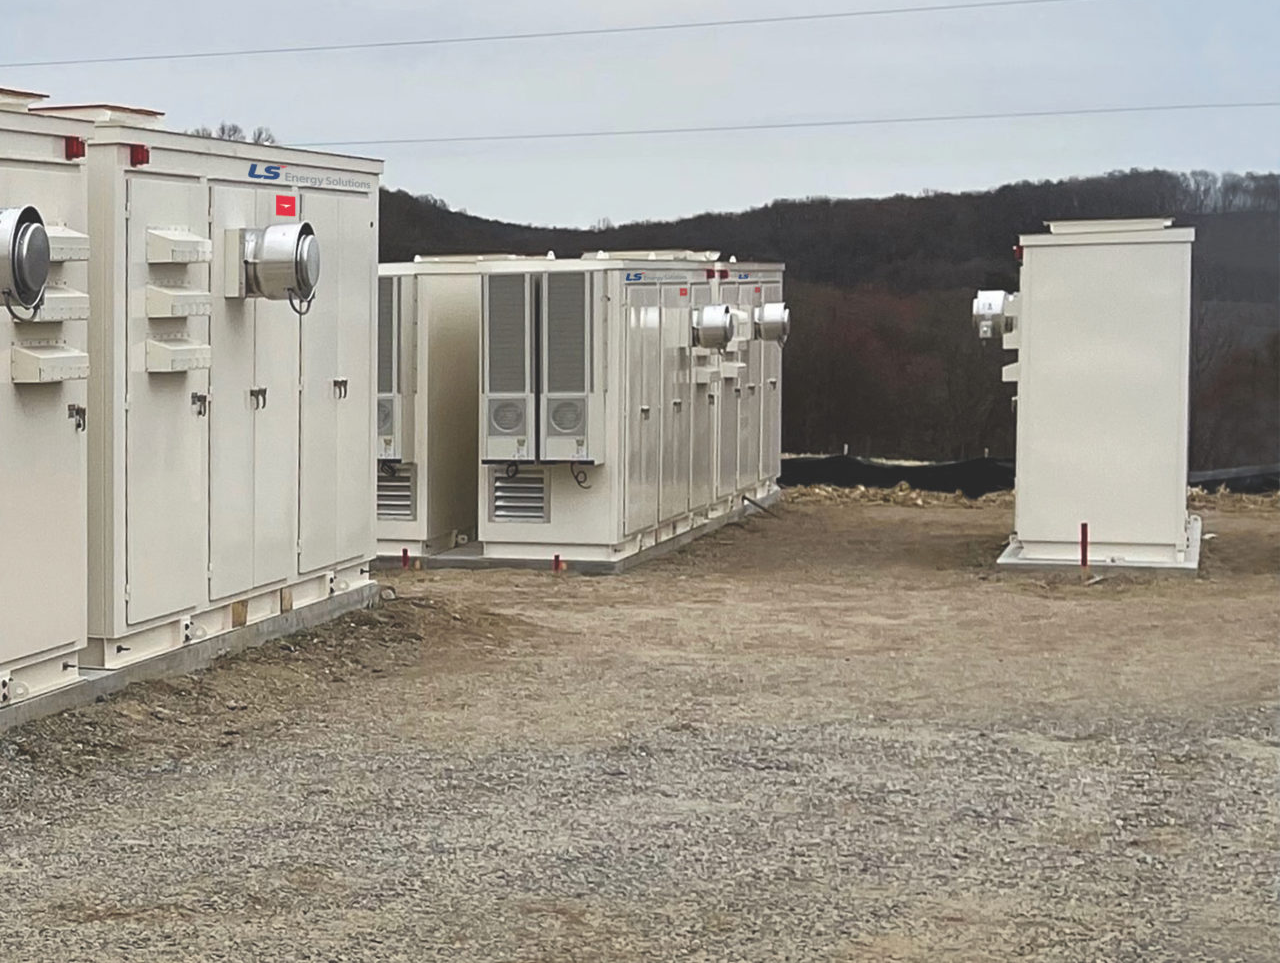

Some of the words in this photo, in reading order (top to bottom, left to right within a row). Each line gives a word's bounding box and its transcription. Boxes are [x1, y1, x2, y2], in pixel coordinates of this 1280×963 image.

[248, 163, 281, 180] LS
[285, 173, 324, 186] Energy
[325, 177, 371, 189] Solutions
[625, 273, 642, 281] LS
